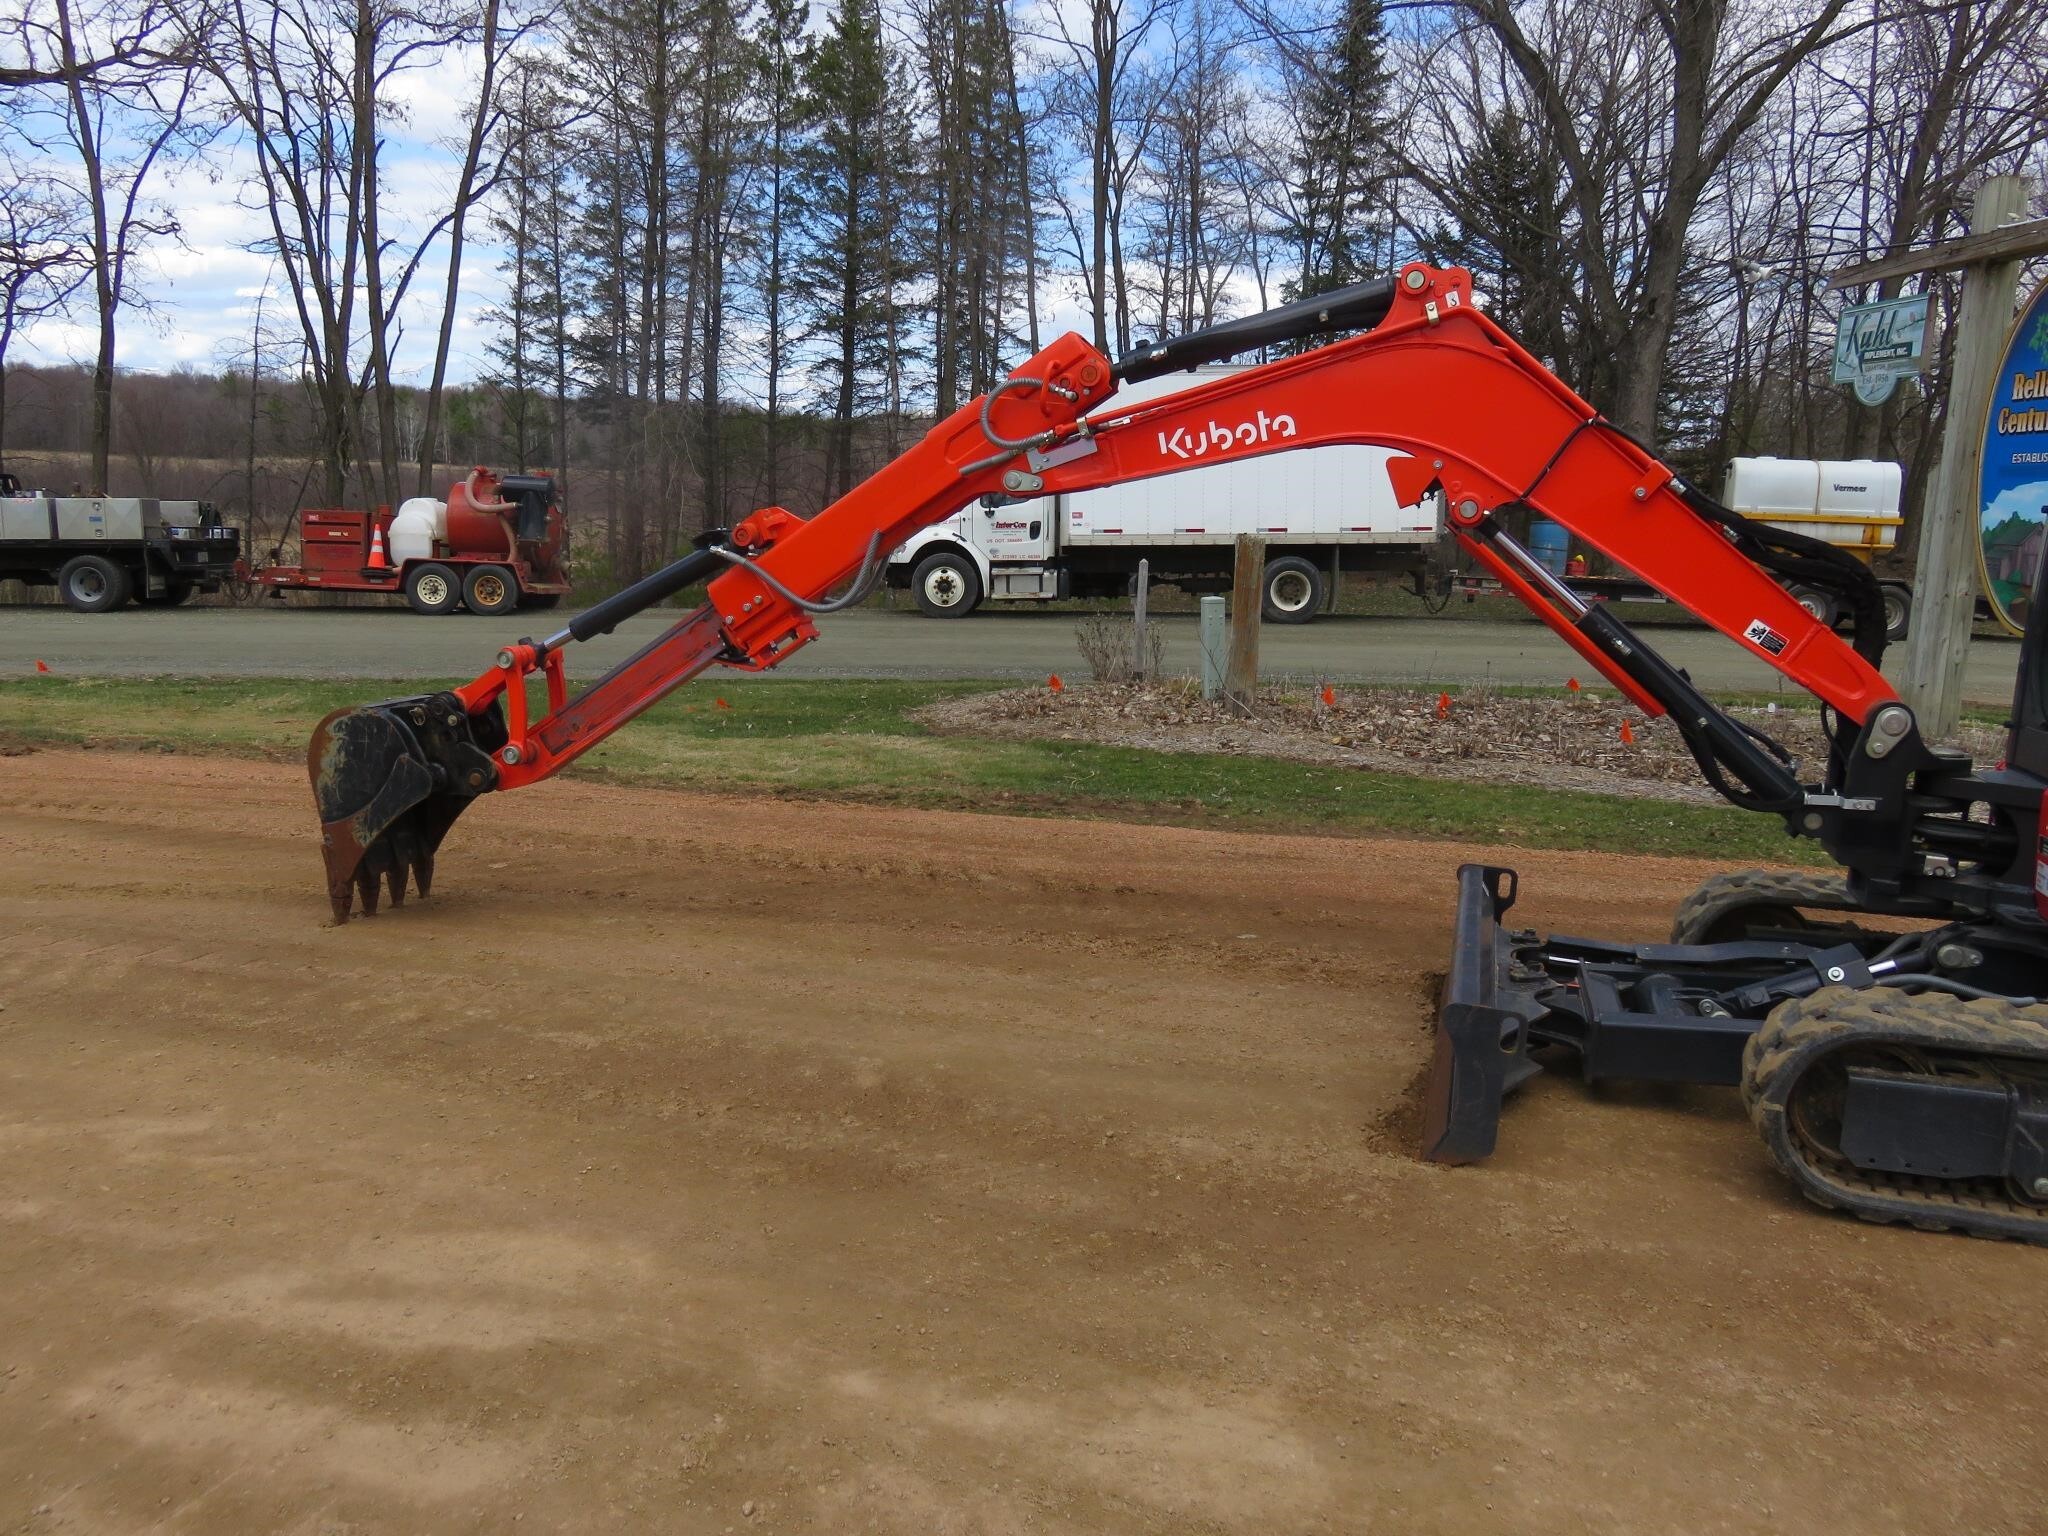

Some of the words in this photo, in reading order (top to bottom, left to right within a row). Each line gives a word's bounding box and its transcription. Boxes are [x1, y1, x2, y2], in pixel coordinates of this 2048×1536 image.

[1846, 310, 1898, 372] Kuhl
[2011, 371, 2048, 400] Rell
[1158, 410, 1296, 459] Kubota
[1998, 407, 2048, 434] Centu
[1833, 483, 1867, 492] Vermeer
